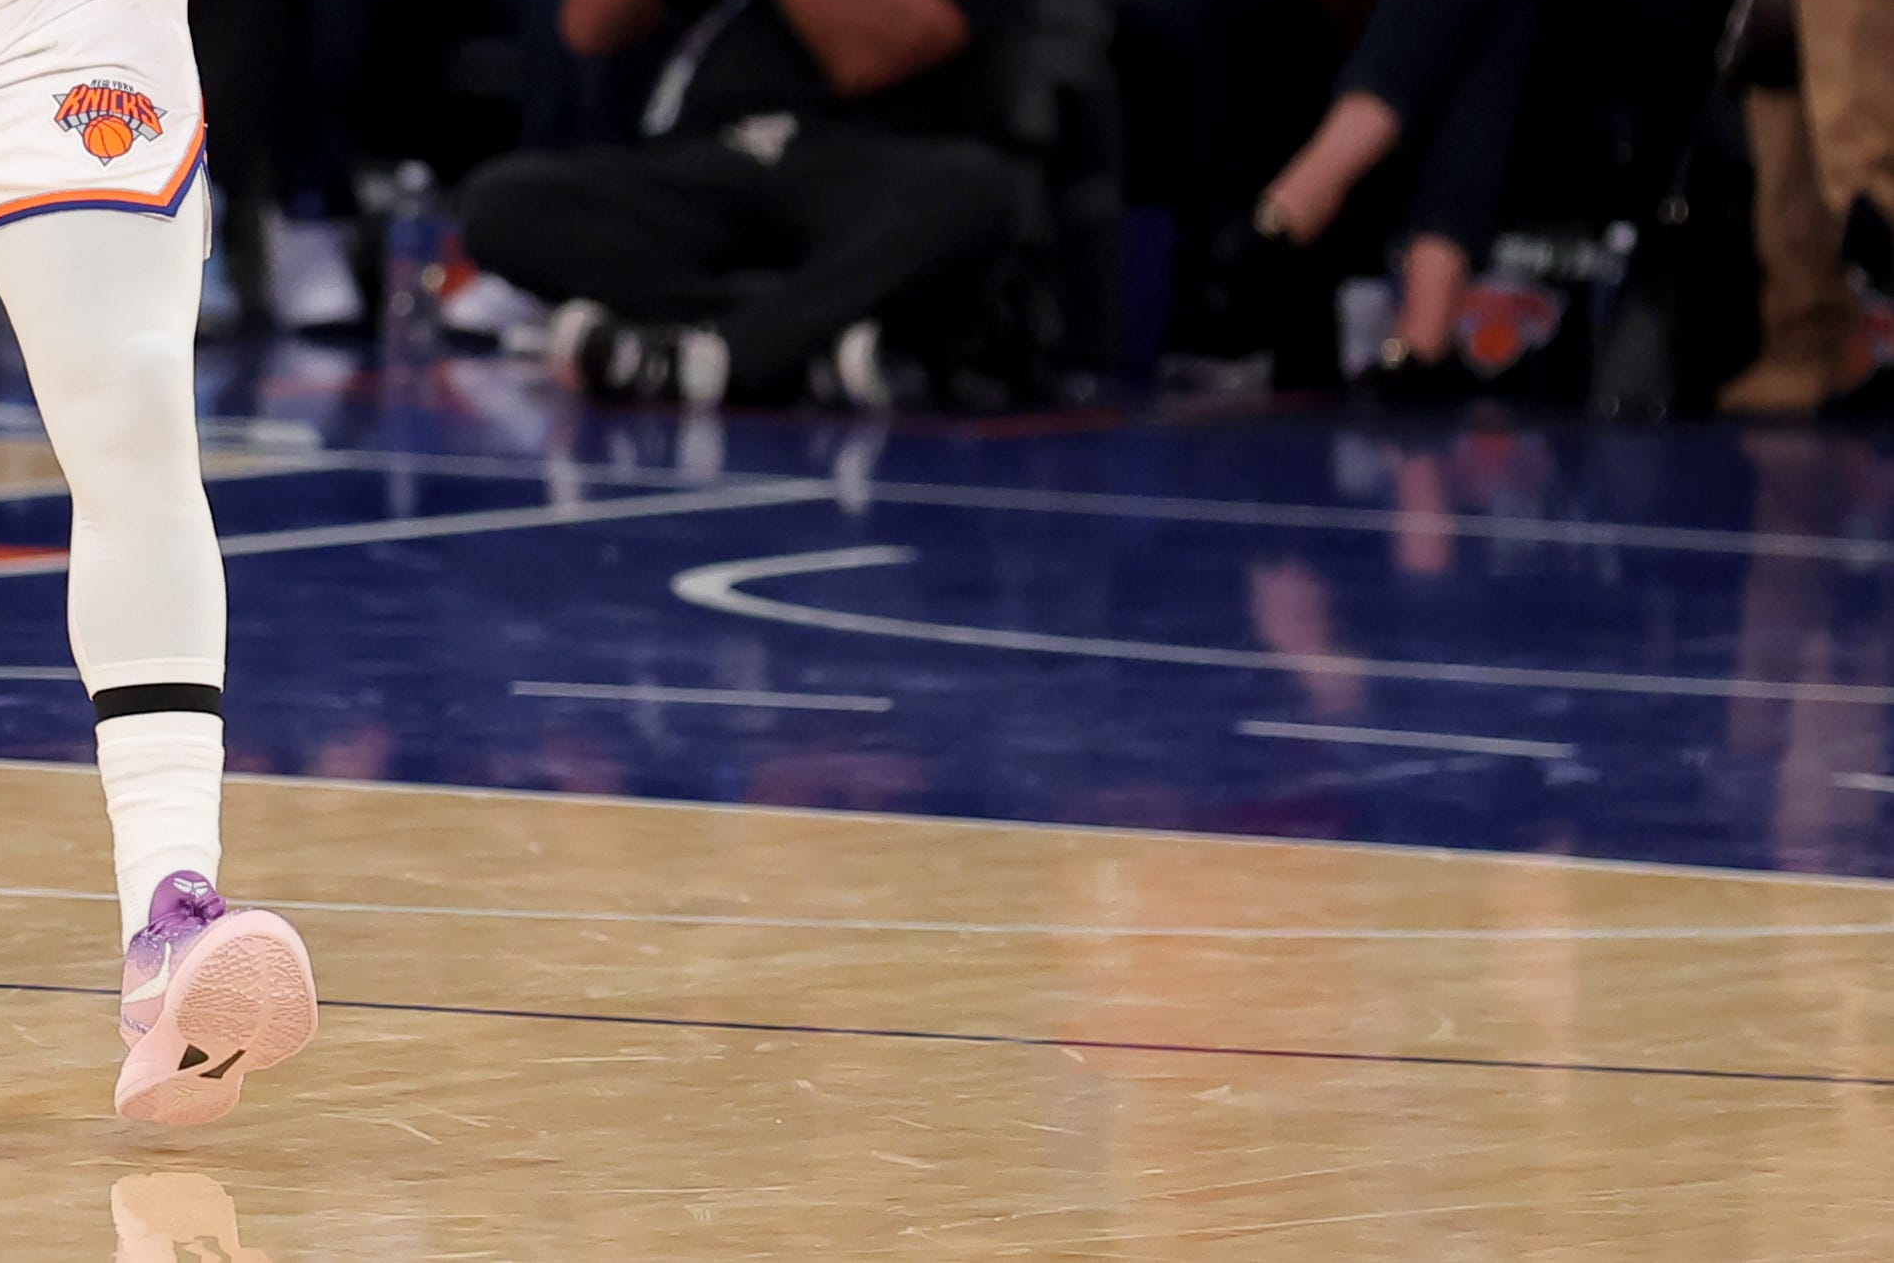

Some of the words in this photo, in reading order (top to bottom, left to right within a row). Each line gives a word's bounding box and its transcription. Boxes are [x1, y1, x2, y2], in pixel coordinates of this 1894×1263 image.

[90, 79, 110, 87] NEW
[112, 79, 134, 92] YORK
[54, 83, 163, 135] KNICKS
